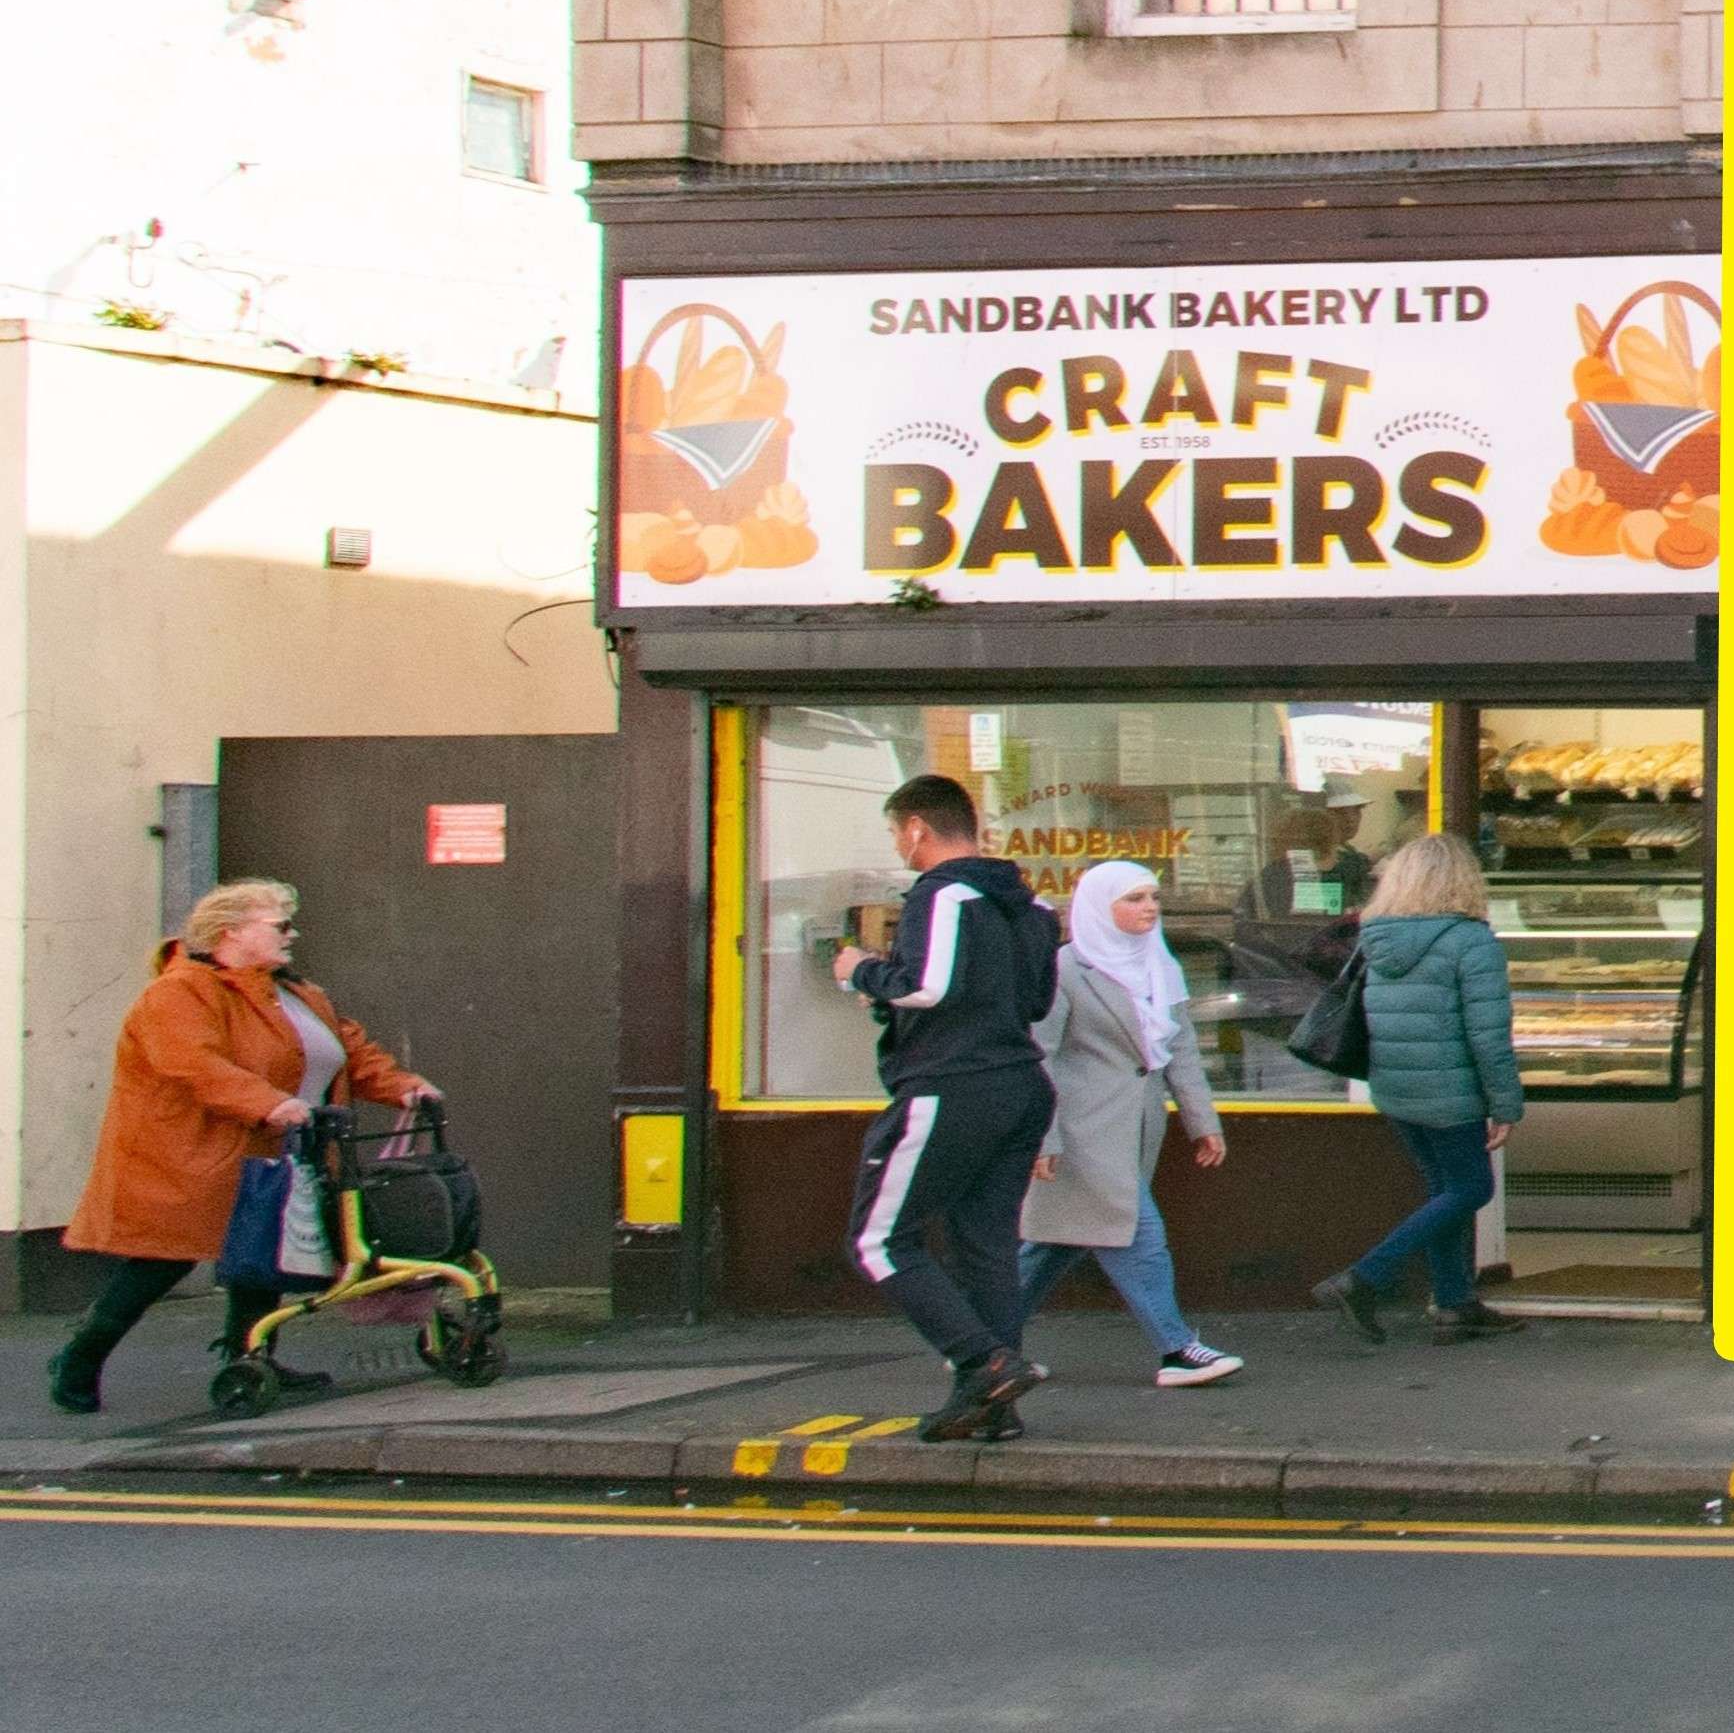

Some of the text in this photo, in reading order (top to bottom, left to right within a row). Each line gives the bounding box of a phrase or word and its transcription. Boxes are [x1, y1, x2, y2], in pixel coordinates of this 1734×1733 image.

[868, 285, 1490, 335] SANDBANK BAKERY LTD
[982, 348, 1374, 448] CRAFT
[1176, 435, 1211, 449] 1958
[862, 451, 1492, 574] BAKERS
[980, 826, 1192, 859] SANDBANK
